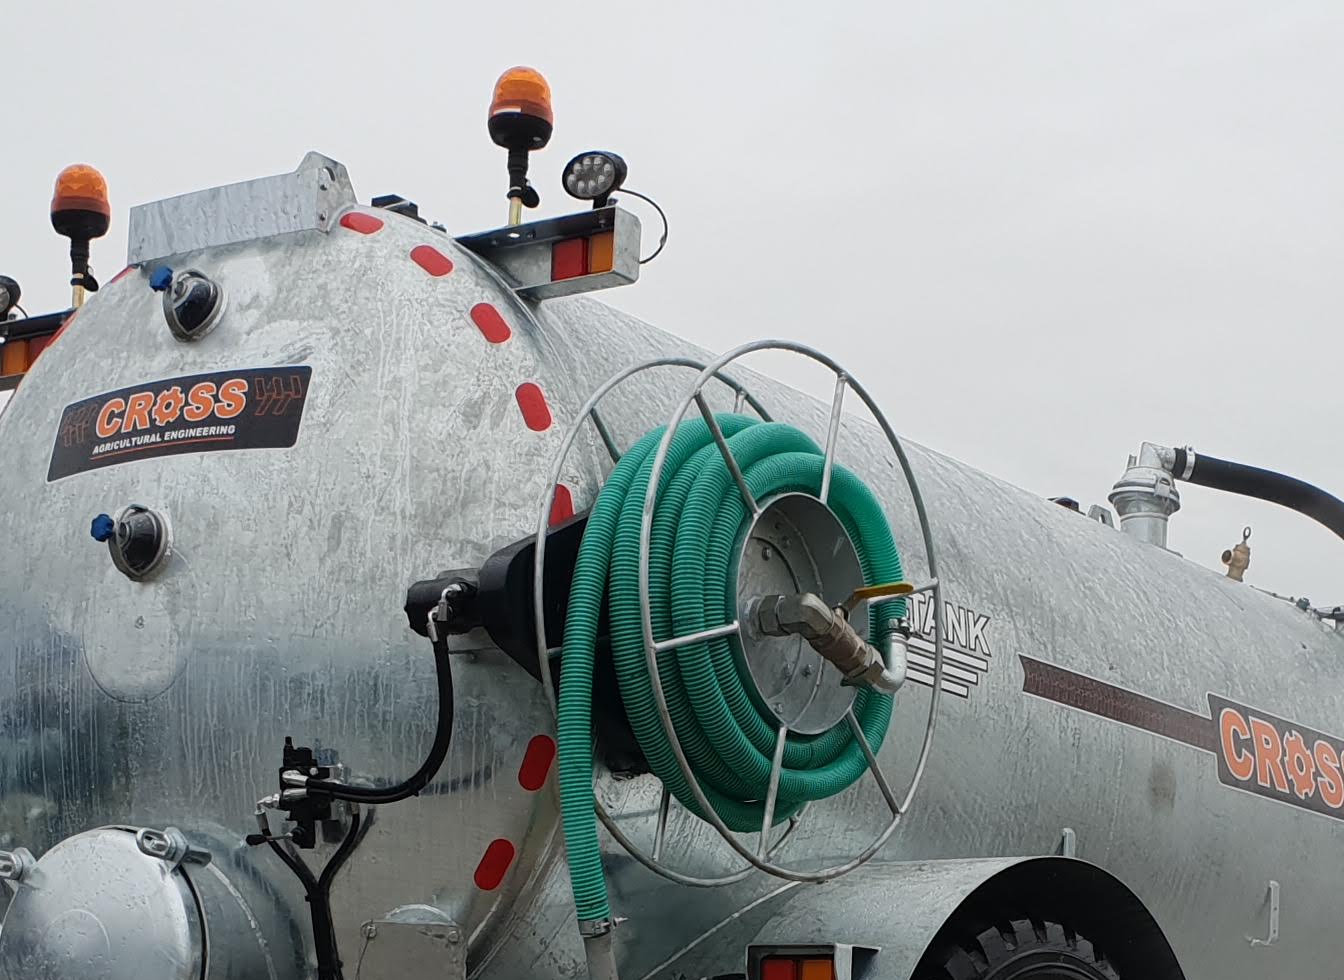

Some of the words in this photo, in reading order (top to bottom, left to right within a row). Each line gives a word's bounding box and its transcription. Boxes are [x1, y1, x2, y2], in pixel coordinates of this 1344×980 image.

[96, 379, 248, 437] CROSS
[92, 434, 162, 455] AGRICULTURAL
[164, 425, 236, 440] ENGINEERING
